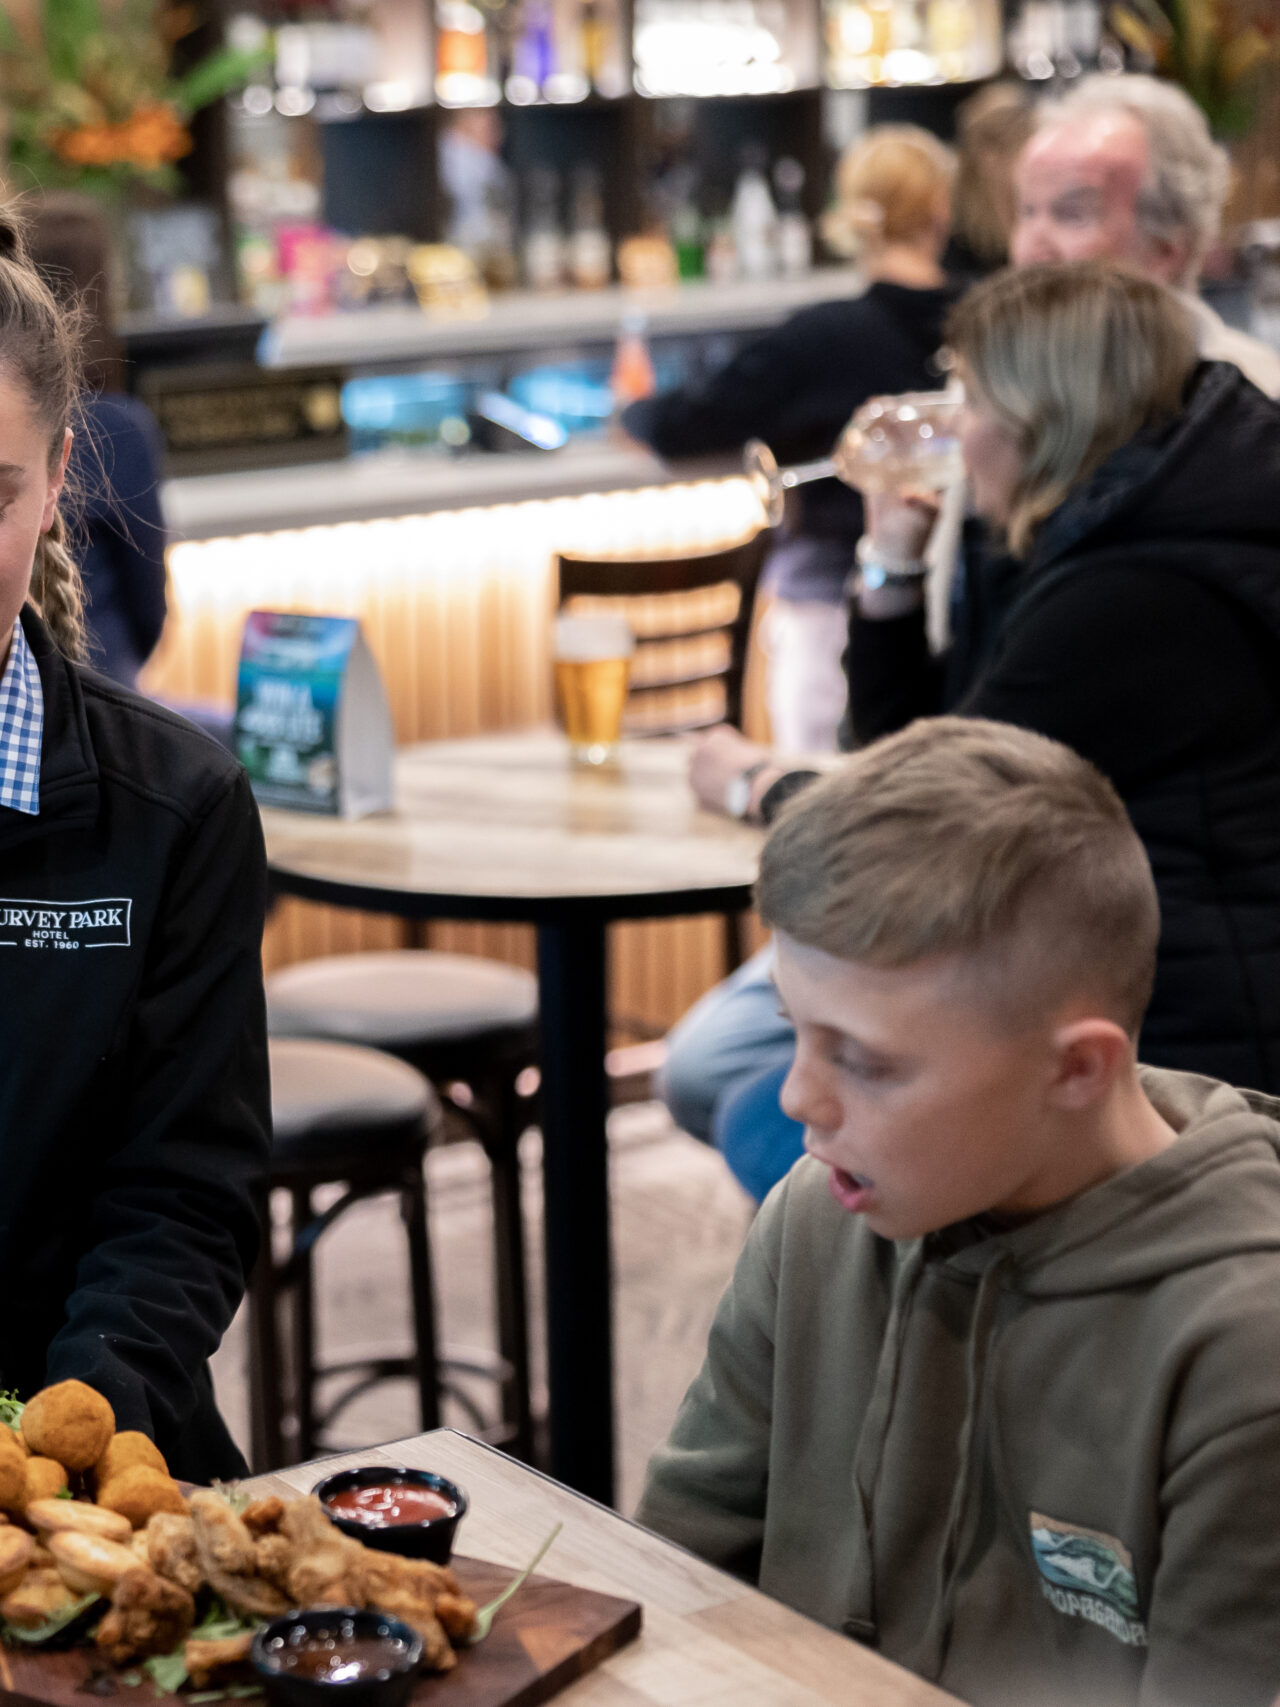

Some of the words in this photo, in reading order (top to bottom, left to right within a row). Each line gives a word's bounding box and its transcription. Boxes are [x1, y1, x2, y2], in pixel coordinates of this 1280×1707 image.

[69, 908, 123, 928] PARK
[32, 930, 69, 940] HOTEL
[24, 938, 49, 949] EST.
[53, 940, 80, 950] 1960
